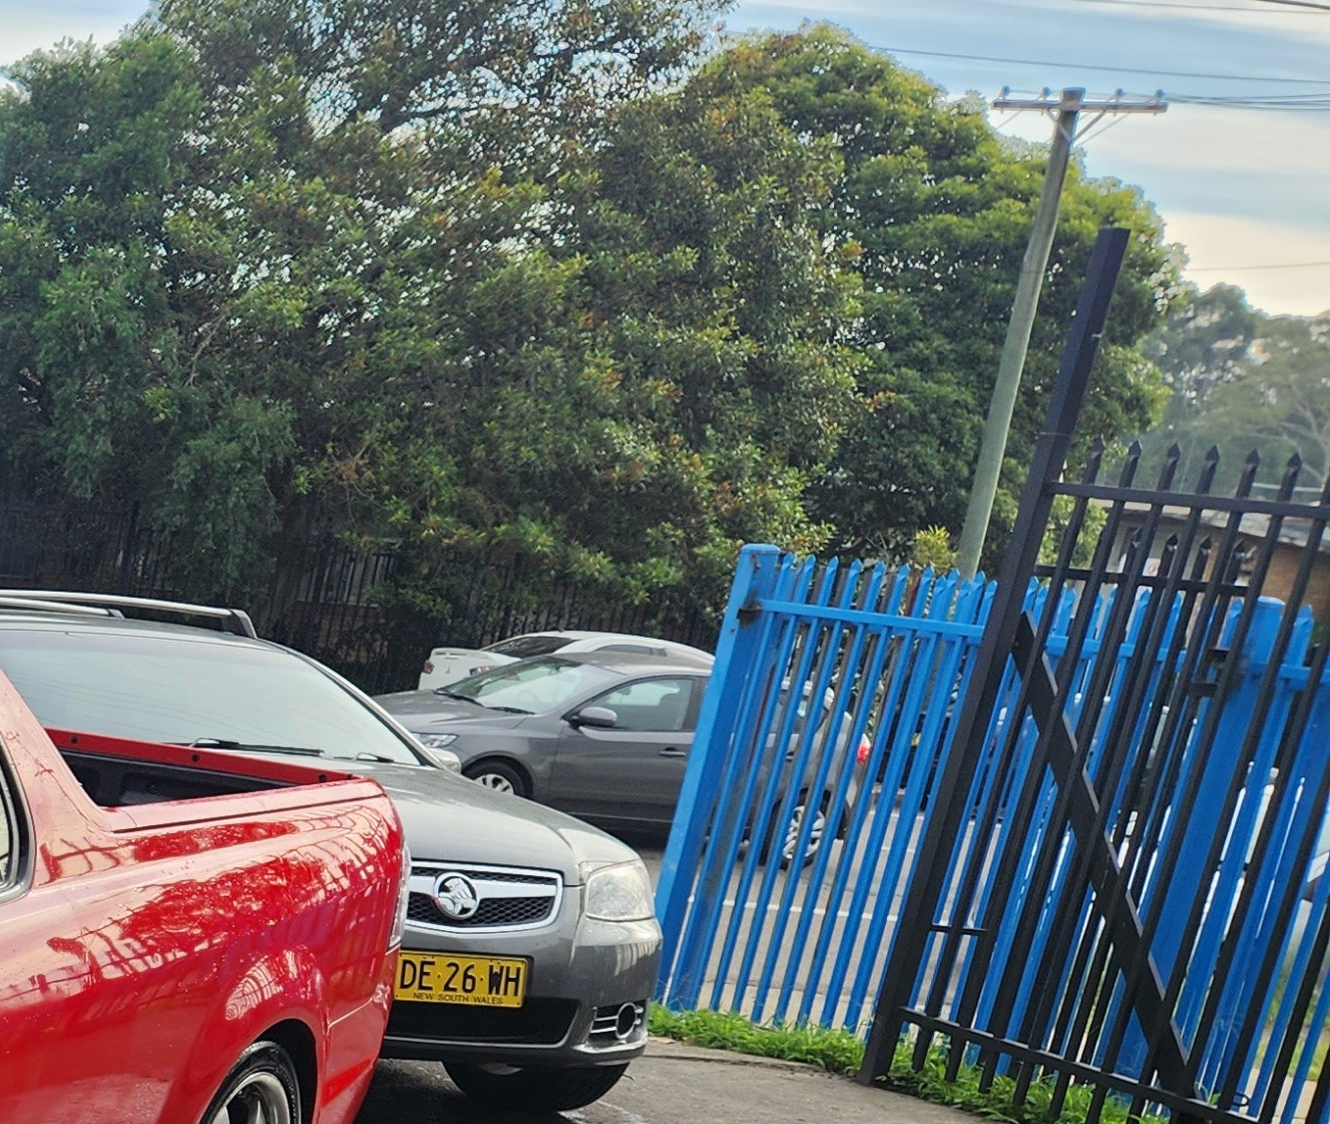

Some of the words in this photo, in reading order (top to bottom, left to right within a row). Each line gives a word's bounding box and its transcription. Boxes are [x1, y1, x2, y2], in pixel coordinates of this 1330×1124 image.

[399, 959, 435, 990] DE
[443, 962, 476, 993] 26
[488, 965, 521, 997] WH
[413, 992, 434, 1000] NEW
[438, 993, 469, 1003] SOUTH
[472, 995, 504, 1005] WALES
